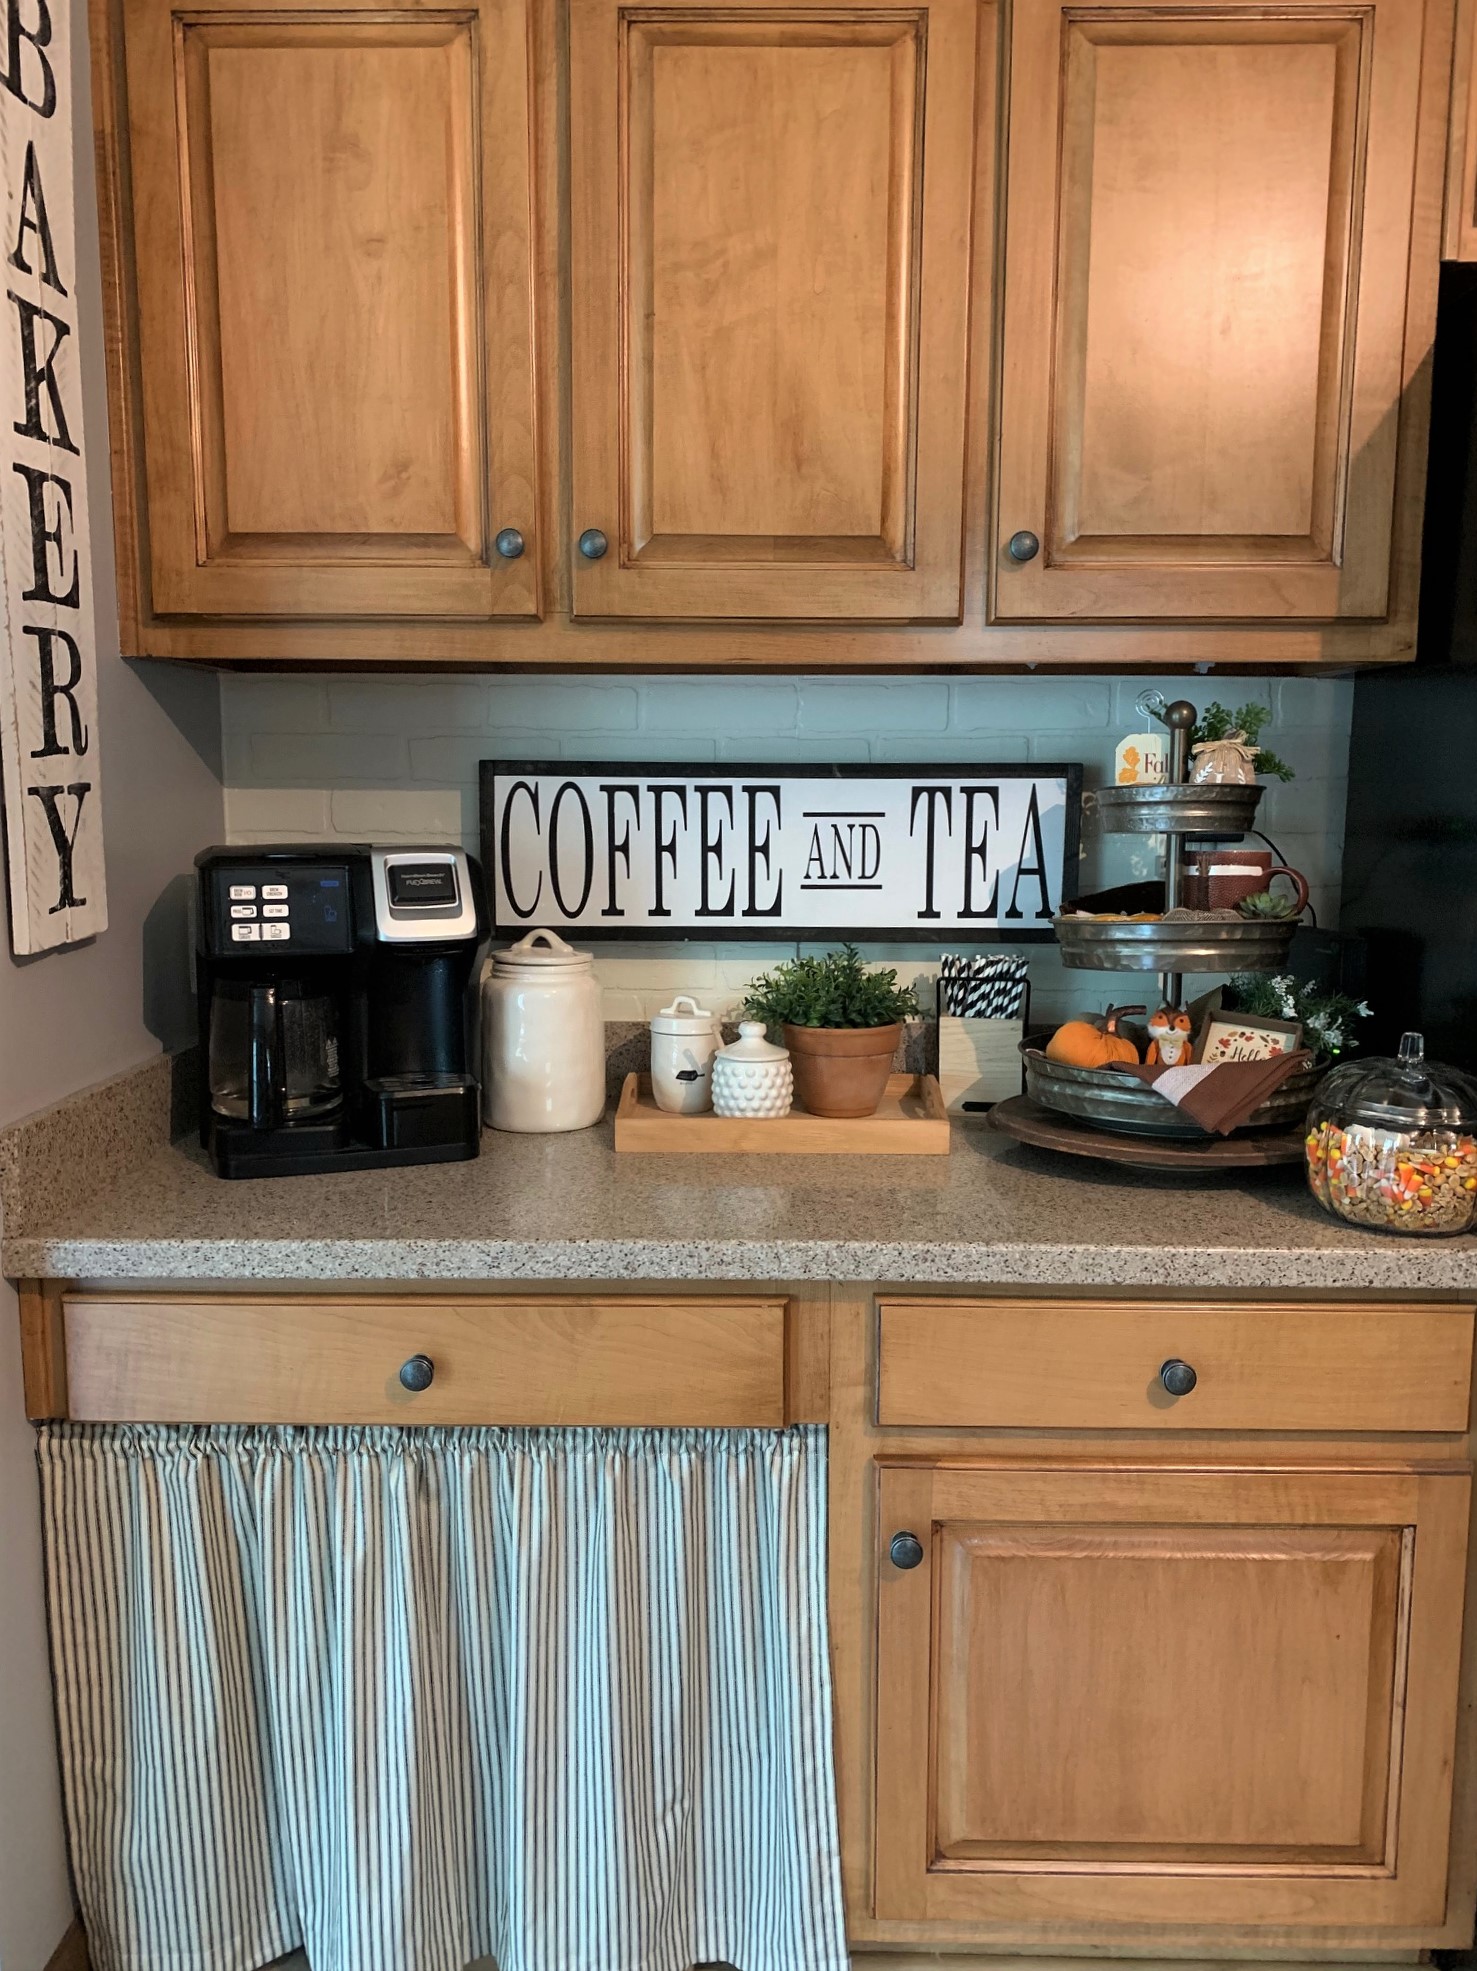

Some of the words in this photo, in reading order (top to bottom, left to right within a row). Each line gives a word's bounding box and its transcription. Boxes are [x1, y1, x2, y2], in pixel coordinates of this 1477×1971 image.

[0, 0, 91, 915] BAKERY
[1144, 752, 1169, 774] Fal
[500, 781, 783, 919] COFFEE
[803, 823, 882, 880] AND
[910, 782, 1056, 919] TEA
[1230, 1046, 1266, 1061] Hell
